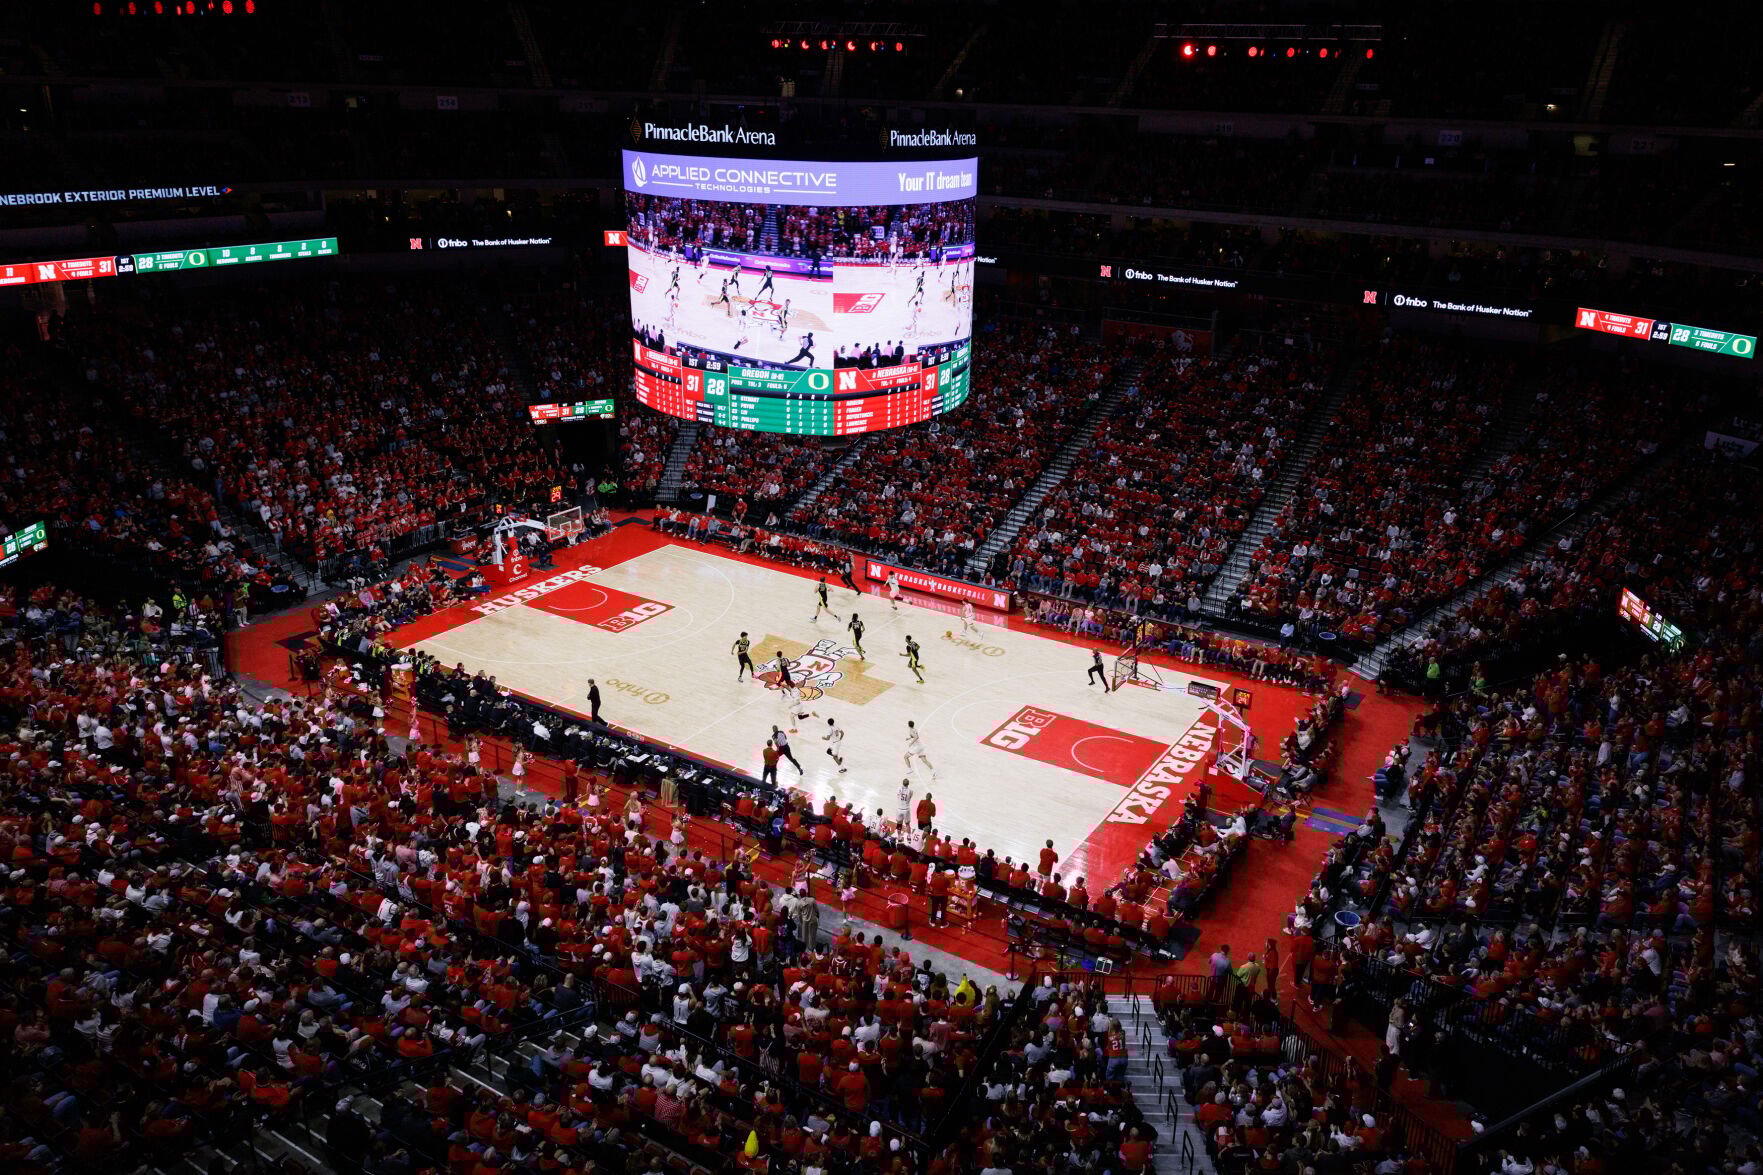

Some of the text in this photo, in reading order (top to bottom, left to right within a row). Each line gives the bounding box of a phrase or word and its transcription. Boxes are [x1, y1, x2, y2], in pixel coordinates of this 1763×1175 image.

[735, 127, 776, 146] Arena
[952, 132, 976, 146] Arena
[651, 164, 837, 187] APPLIED CONNECTIVE
[898, 173, 924, 192] Your
[926, 172, 935, 191] IT
[936, 169, 960, 190] dream
[64, 190, 126, 203] EXTERIOR
[129, 188, 183, 200] PREMIUM
[185, 186, 220, 197] LEVEL
[695, 182, 771, 194] TECHNOLOGIES
[410, 238, 423, 250] N
[449, 239, 468, 248] fnbo
[608, 233, 620, 244] N
[138, 256, 154, 270] 28
[188, 252, 206, 266] O
[37, 264, 57, 280] N
[99, 260, 112, 273] 31
[1100, 265, 1112, 277] N
[1134, 270, 1153, 280] fnbo
[1157, 273, 1168, 282] The
[1169, 275, 1184, 283] Bank
[1184, 276, 1192, 284] of
[1192, 277, 1213, 286] Husker
[1363, 291, 1377, 304] N
[1405, 297, 1428, 307] fnbo
[1433, 300, 1447, 309] The
[1447, 303, 1466, 312] Bank
[1466, 304, 1475, 312] of
[1475, 304, 1502, 315] Husker
[1580, 311, 1596, 327] N
[1634, 321, 1649, 335] 31
[1672, 328, 1691, 342] 28
[1700, 341, 1718, 349] FOULS
[1731, 338, 1752, 354] O
[688, 358, 698, 367] 1ST
[705, 361, 721, 371] 2:59
[741, 368, 770, 379] OREGON
[877, 366, 907, 378] NEBRASKA
[686, 374, 725, 396] 31 28
[808, 372, 829, 390] O
[838, 371, 857, 390] N
[925, 368, 951, 391] 31 28
[870, 564, 882, 578] N
[471, 564, 602, 615] HUSKERS
[895, 572, 986, 600] EBRASKA BASKETBALL
[993, 593, 1006, 608] N
[599, 602, 668, 632] BIG
[990, 708, 1057, 750] BIG
[1107, 721, 1219, 825] NEBRASKA
[900, 793, 908, 801] 51
